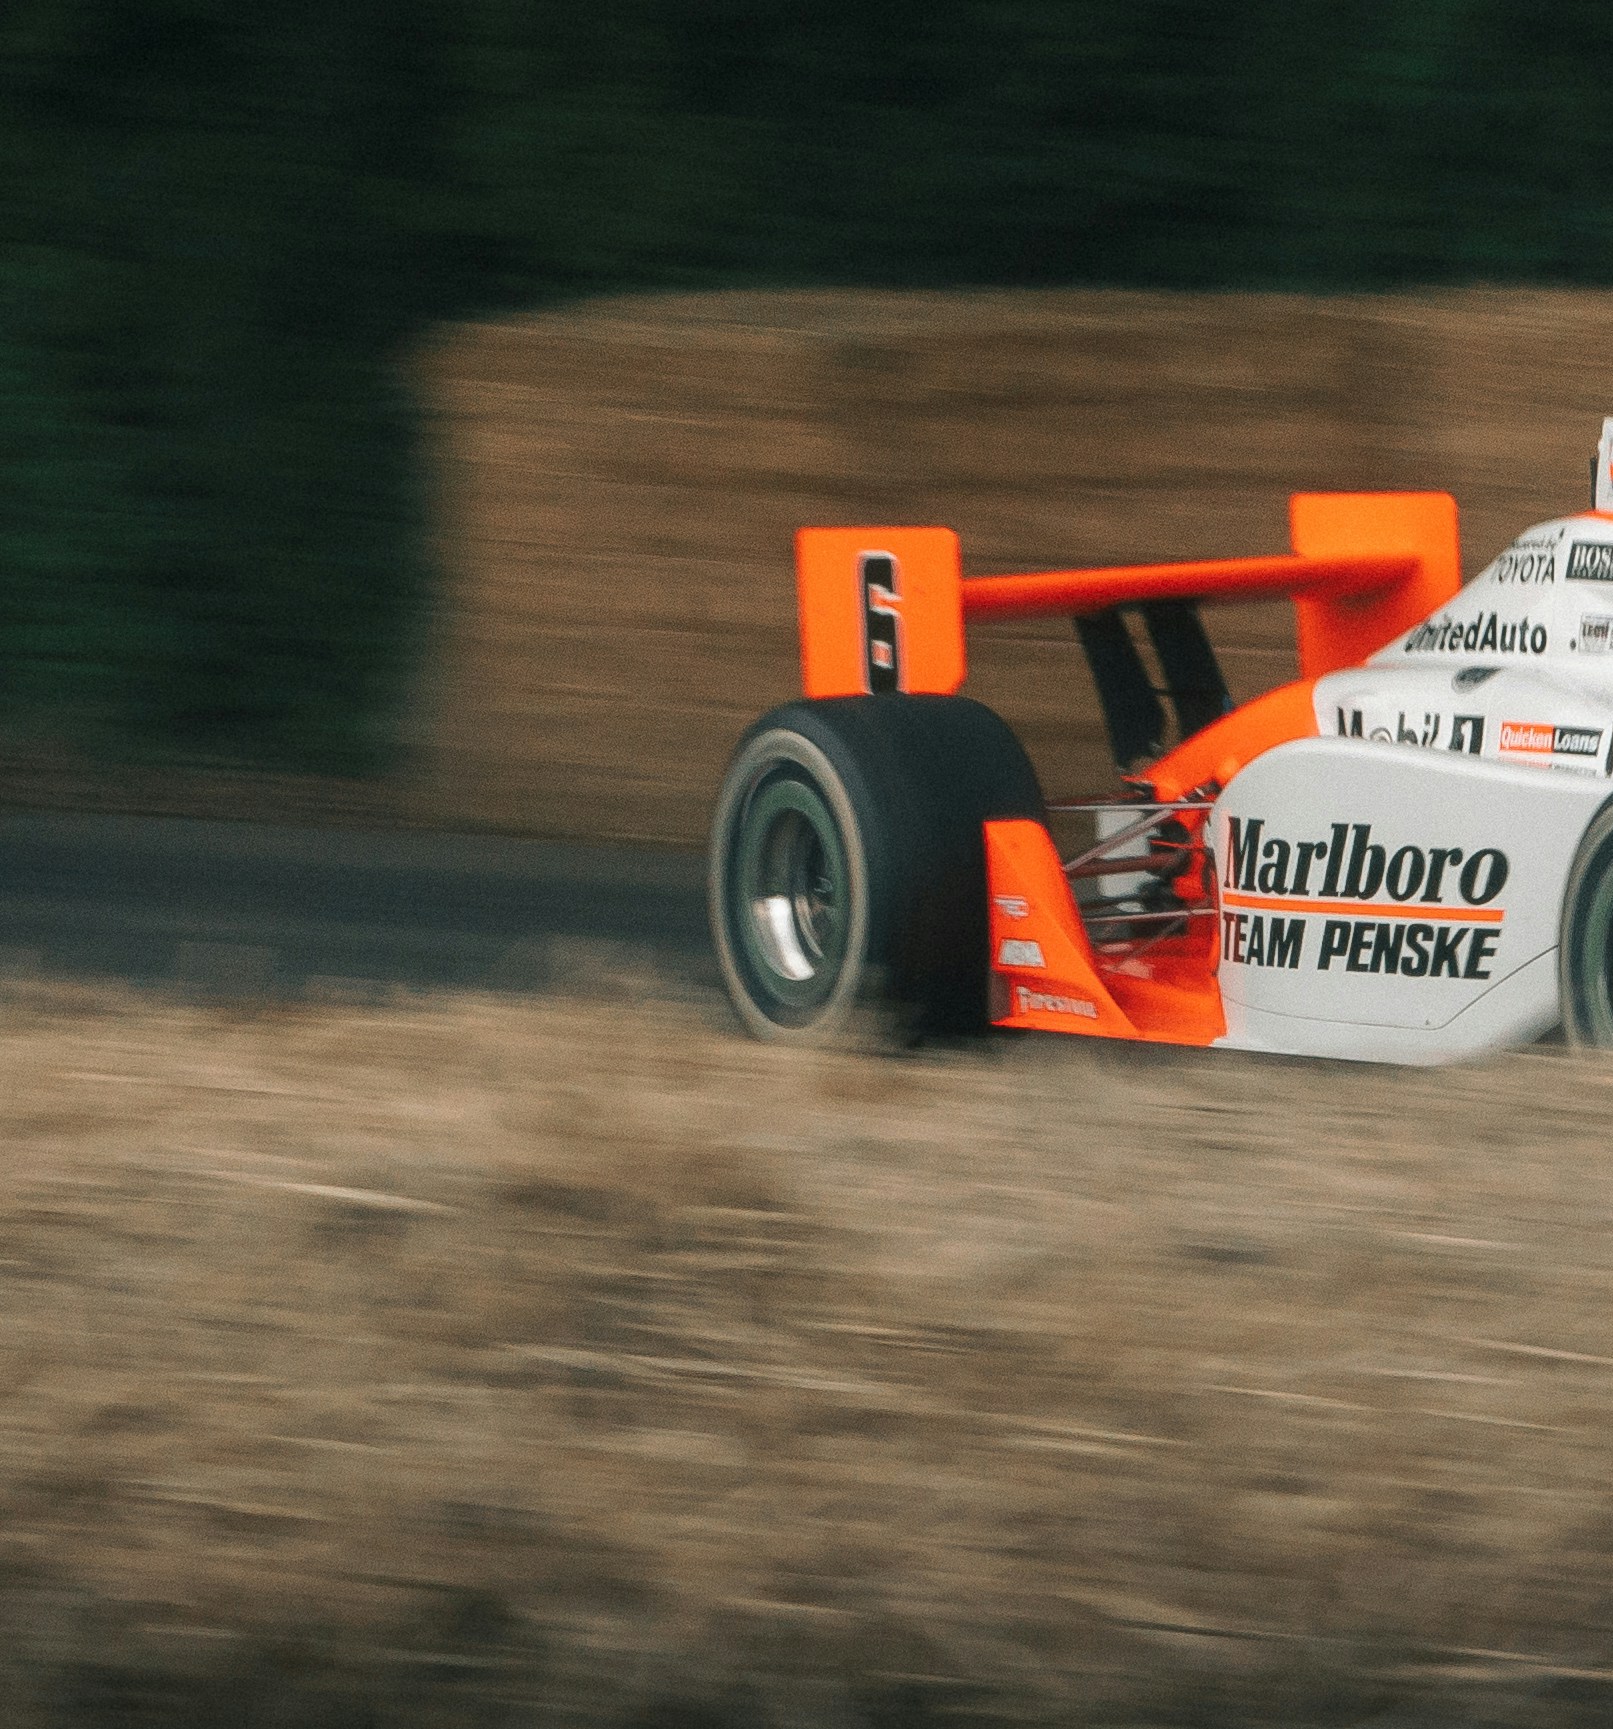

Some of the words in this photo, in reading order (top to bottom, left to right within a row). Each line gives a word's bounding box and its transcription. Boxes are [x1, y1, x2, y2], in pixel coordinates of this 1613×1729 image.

[1490, 553, 1556, 585] TOYOTA
[858, 550, 905, 695] 6
[1501, 725, 1553, 749] Quicken
[1554, 728, 1599, 753] Loans
[1223, 816, 1509, 905] Marlboro
[1223, 911, 1306, 969] TEAM
[1317, 920, 1502, 980] PENSKE
